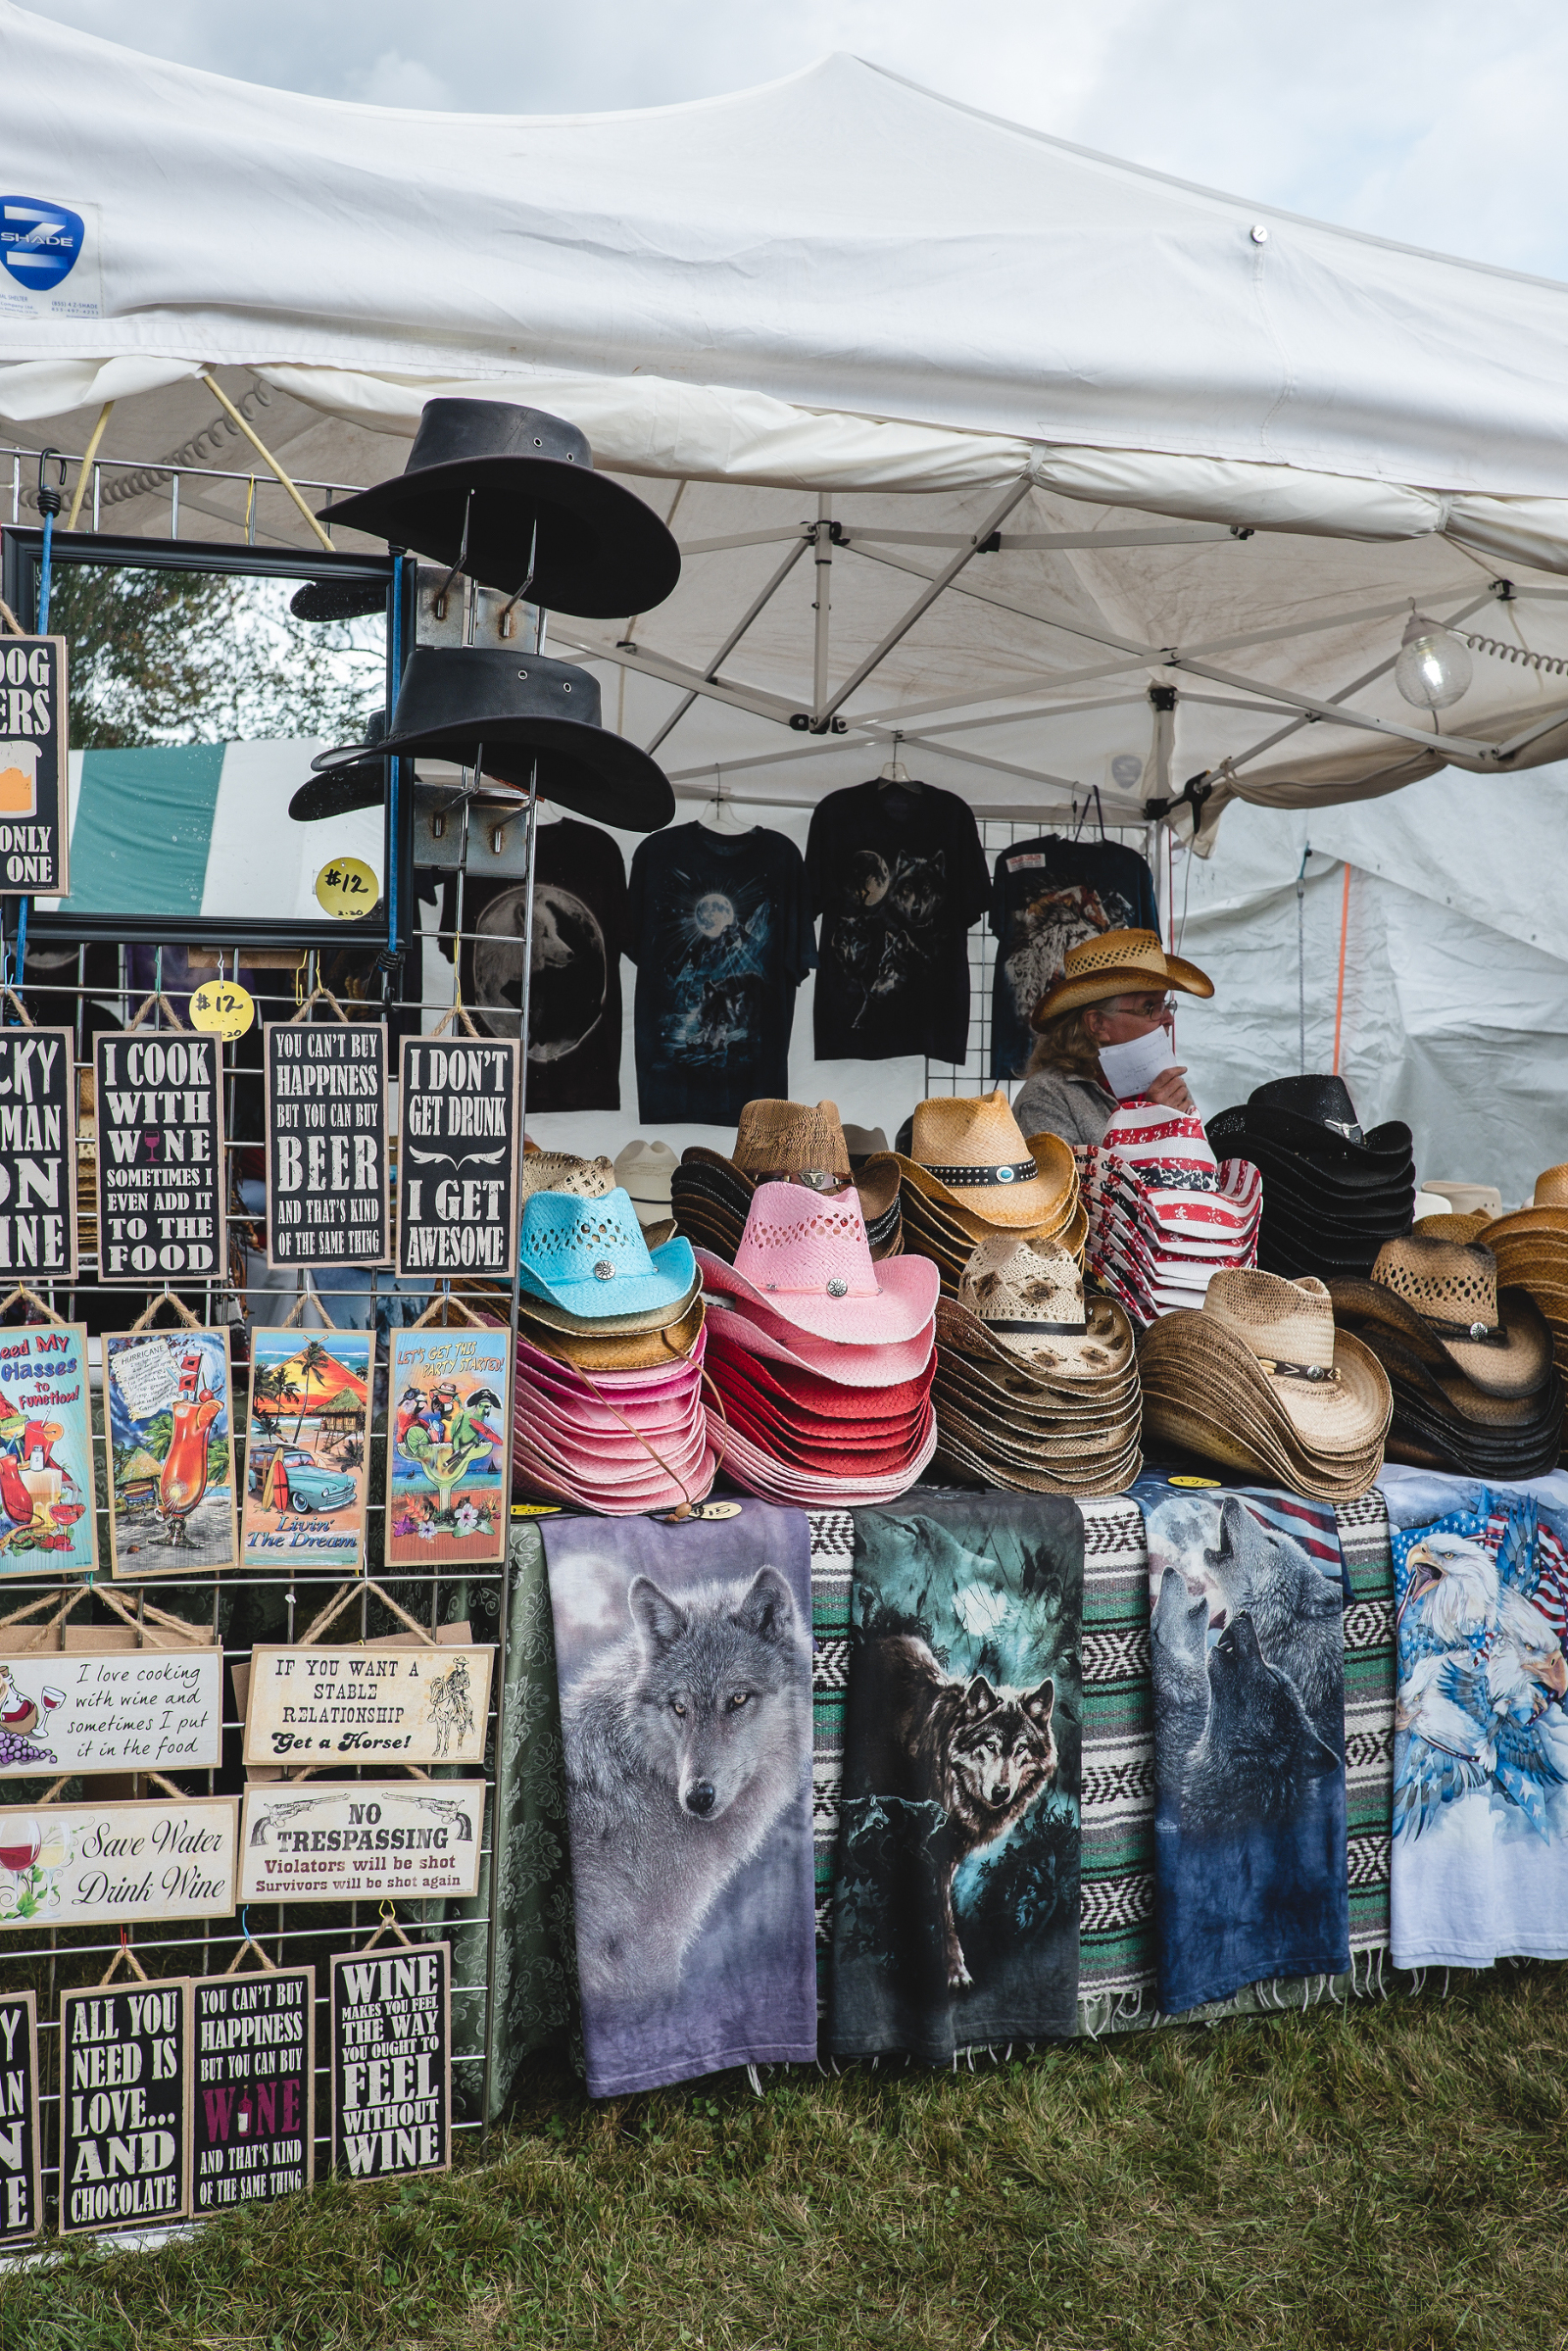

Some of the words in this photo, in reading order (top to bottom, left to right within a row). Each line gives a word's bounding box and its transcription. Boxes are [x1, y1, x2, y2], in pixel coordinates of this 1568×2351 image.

[0, 231, 74, 248] SHADE
[0, 648, 50, 687] OG
[0, 825, 52, 854] ONLY
[6, 856, 53, 883] ONE
[195, 993, 244, 1013] $12
[275, 1033, 303, 1058] YOU
[307, 1034, 347, 1058] CAN'T
[351, 1033, 378, 1057] BUY
[104, 1043, 118, 1087] I
[126, 1042, 212, 1087] COOK
[409, 1049, 421, 1090] I
[428, 1049, 509, 1092] DON'T
[275, 1064, 378, 1097] HAPPINESS
[105, 1091, 212, 1125] WITH
[276, 1103, 300, 1128] BUT
[304, 1103, 326, 1128] YOU
[330, 1103, 352, 1127] CAN
[355, 1103, 378, 1127] BUY
[408, 1095, 444, 1136] GET
[447, 1096, 507, 1137] DRUNK
[0, 1104, 61, 1152] MAN
[276, 1135, 379, 1192] BEER
[0, 1158, 62, 1209] N
[107, 1168, 201, 1188] SOMETIMES
[205, 1168, 213, 1187] I
[107, 1193, 149, 1212] EVEN
[153, 1192, 191, 1211] ADD
[195, 1192, 214, 1210] IT
[278, 1200, 302, 1225] AND
[306, 1199, 346, 1224] THAT'S
[350, 1198, 379, 1222] KIND
[407, 1179, 422, 1221] I
[434, 1179, 506, 1222] GET
[107, 1217, 148, 1240] TO
[157, 1216, 214, 1240] THE
[278, 1231, 292, 1256] OF
[295, 1231, 316, 1255] THE
[318, 1230, 345, 1254] SAME
[348, 1229, 380, 1254] THING
[406, 1226, 505, 1267] AWESOME
[108, 1244, 215, 1272] FOOD
[0, 1339, 30, 1359] eed
[35, 1334, 70, 1353] My
[122, 1345, 165, 1365] HURRICANE
[397, 1347, 424, 1366] LET'S
[427, 1345, 451, 1361] GET
[455, 1341, 477, 1357] THIS
[1, 1357, 77, 1383] Glasses
[422, 1359, 455, 1379] PARTY
[459, 1356, 505, 1374] STARTED!
[19, 1385, 80, 1410] Function!
[34, 1381, 50, 1393] to
[274, 1515, 335, 1532] Livin'
[247, 1532, 285, 1547] The
[289, 1532, 358, 1547] Dream
[76, 1663, 92, 1684] I
[97, 1664, 129, 1683] love
[137, 1662, 201, 1689] cooking
[275, 1659, 296, 1676] IF
[306, 1659, 340, 1677] YOU
[348, 1660, 399, 1677] WANT
[408, 1660, 419, 1677] A
[75, 1690, 113, 1708] with
[121, 1690, 158, 1708] wine
[165, 1688, 202, 1705] and
[314, 1683, 378, 1700] STABLE
[67, 1715, 154, 1734] sometimes
[159, 1710, 174, 1731] I
[177, 1711, 209, 1736] put
[281, 1706, 405, 1724] RELATIONSHIP
[76, 1740, 94, 1758] it
[99, 1739, 117, 1757] in
[122, 1738, 150, 1756] the
[155, 1736, 199, 1761] food
[270, 1732, 314, 1754] Get
[318, 1739, 331, 1749] a
[337, 1731, 412, 1751] Horse!
[348, 1802, 382, 1826] NO
[81, 1822, 145, 1859] Save
[151, 1819, 224, 1855] Water
[276, 1827, 449, 1853] TRESPASSING
[264, 1858, 346, 1875] Violators
[352, 1856, 387, 1872] will
[393, 1855, 413, 1871] be
[418, 1854, 457, 1870] shot
[72, 1869, 155, 1906] Drink
[162, 1865, 225, 1901] Wine
[256, 1880, 328, 1892] Survivors
[332, 1878, 362, 1890] will
[366, 1877, 382, 1889] be
[387, 1876, 417, 1888] shot
[421, 1875, 461, 1889] again
[341, 1954, 439, 2006] WINE
[201, 1989, 227, 2015] YOU
[231, 1984, 271, 2011] CAN'T
[276, 1982, 304, 2006] BUY
[342, 2004, 382, 2022] MAKES
[385, 1999, 408, 2016] YOU
[411, 1995, 439, 2012] FEEL
[72, 1998, 121, 2044] ALL
[127, 1990, 178, 2036] YOU
[342, 2017, 384, 2045] THE
[391, 2011, 439, 2039] WAY
[200, 2011, 303, 2051] HAPPINESS
[341, 2045, 368, 2063] YOU
[371, 2038, 417, 2059] OUGHT
[420, 2034, 440, 2052] TO
[72, 2041, 143, 2090] NEED
[151, 2036, 177, 2081] IS
[200, 2058, 223, 2082] BUT
[228, 2054, 251, 2079] YOU
[254, 2050, 276, 2076] CAN
[279, 2047, 303, 2073] BUY
[343, 2053, 440, 2111] FEEL
[343, 2099, 439, 2134] WITHOUT
[71, 2130, 176, 2184] AND
[199, 2151, 223, 2176] AND
[227, 2142, 269, 2172] THAT'S
[272, 2138, 303, 2165] KIND
[343, 2123, 440, 2177] WINE
[71, 2175, 176, 2224] CHOCOLATE
[199, 2181, 214, 2206] OF
[217, 2178, 237, 2203] THE
[240, 2173, 268, 2201] SAME
[270, 2169, 302, 2196] THING
